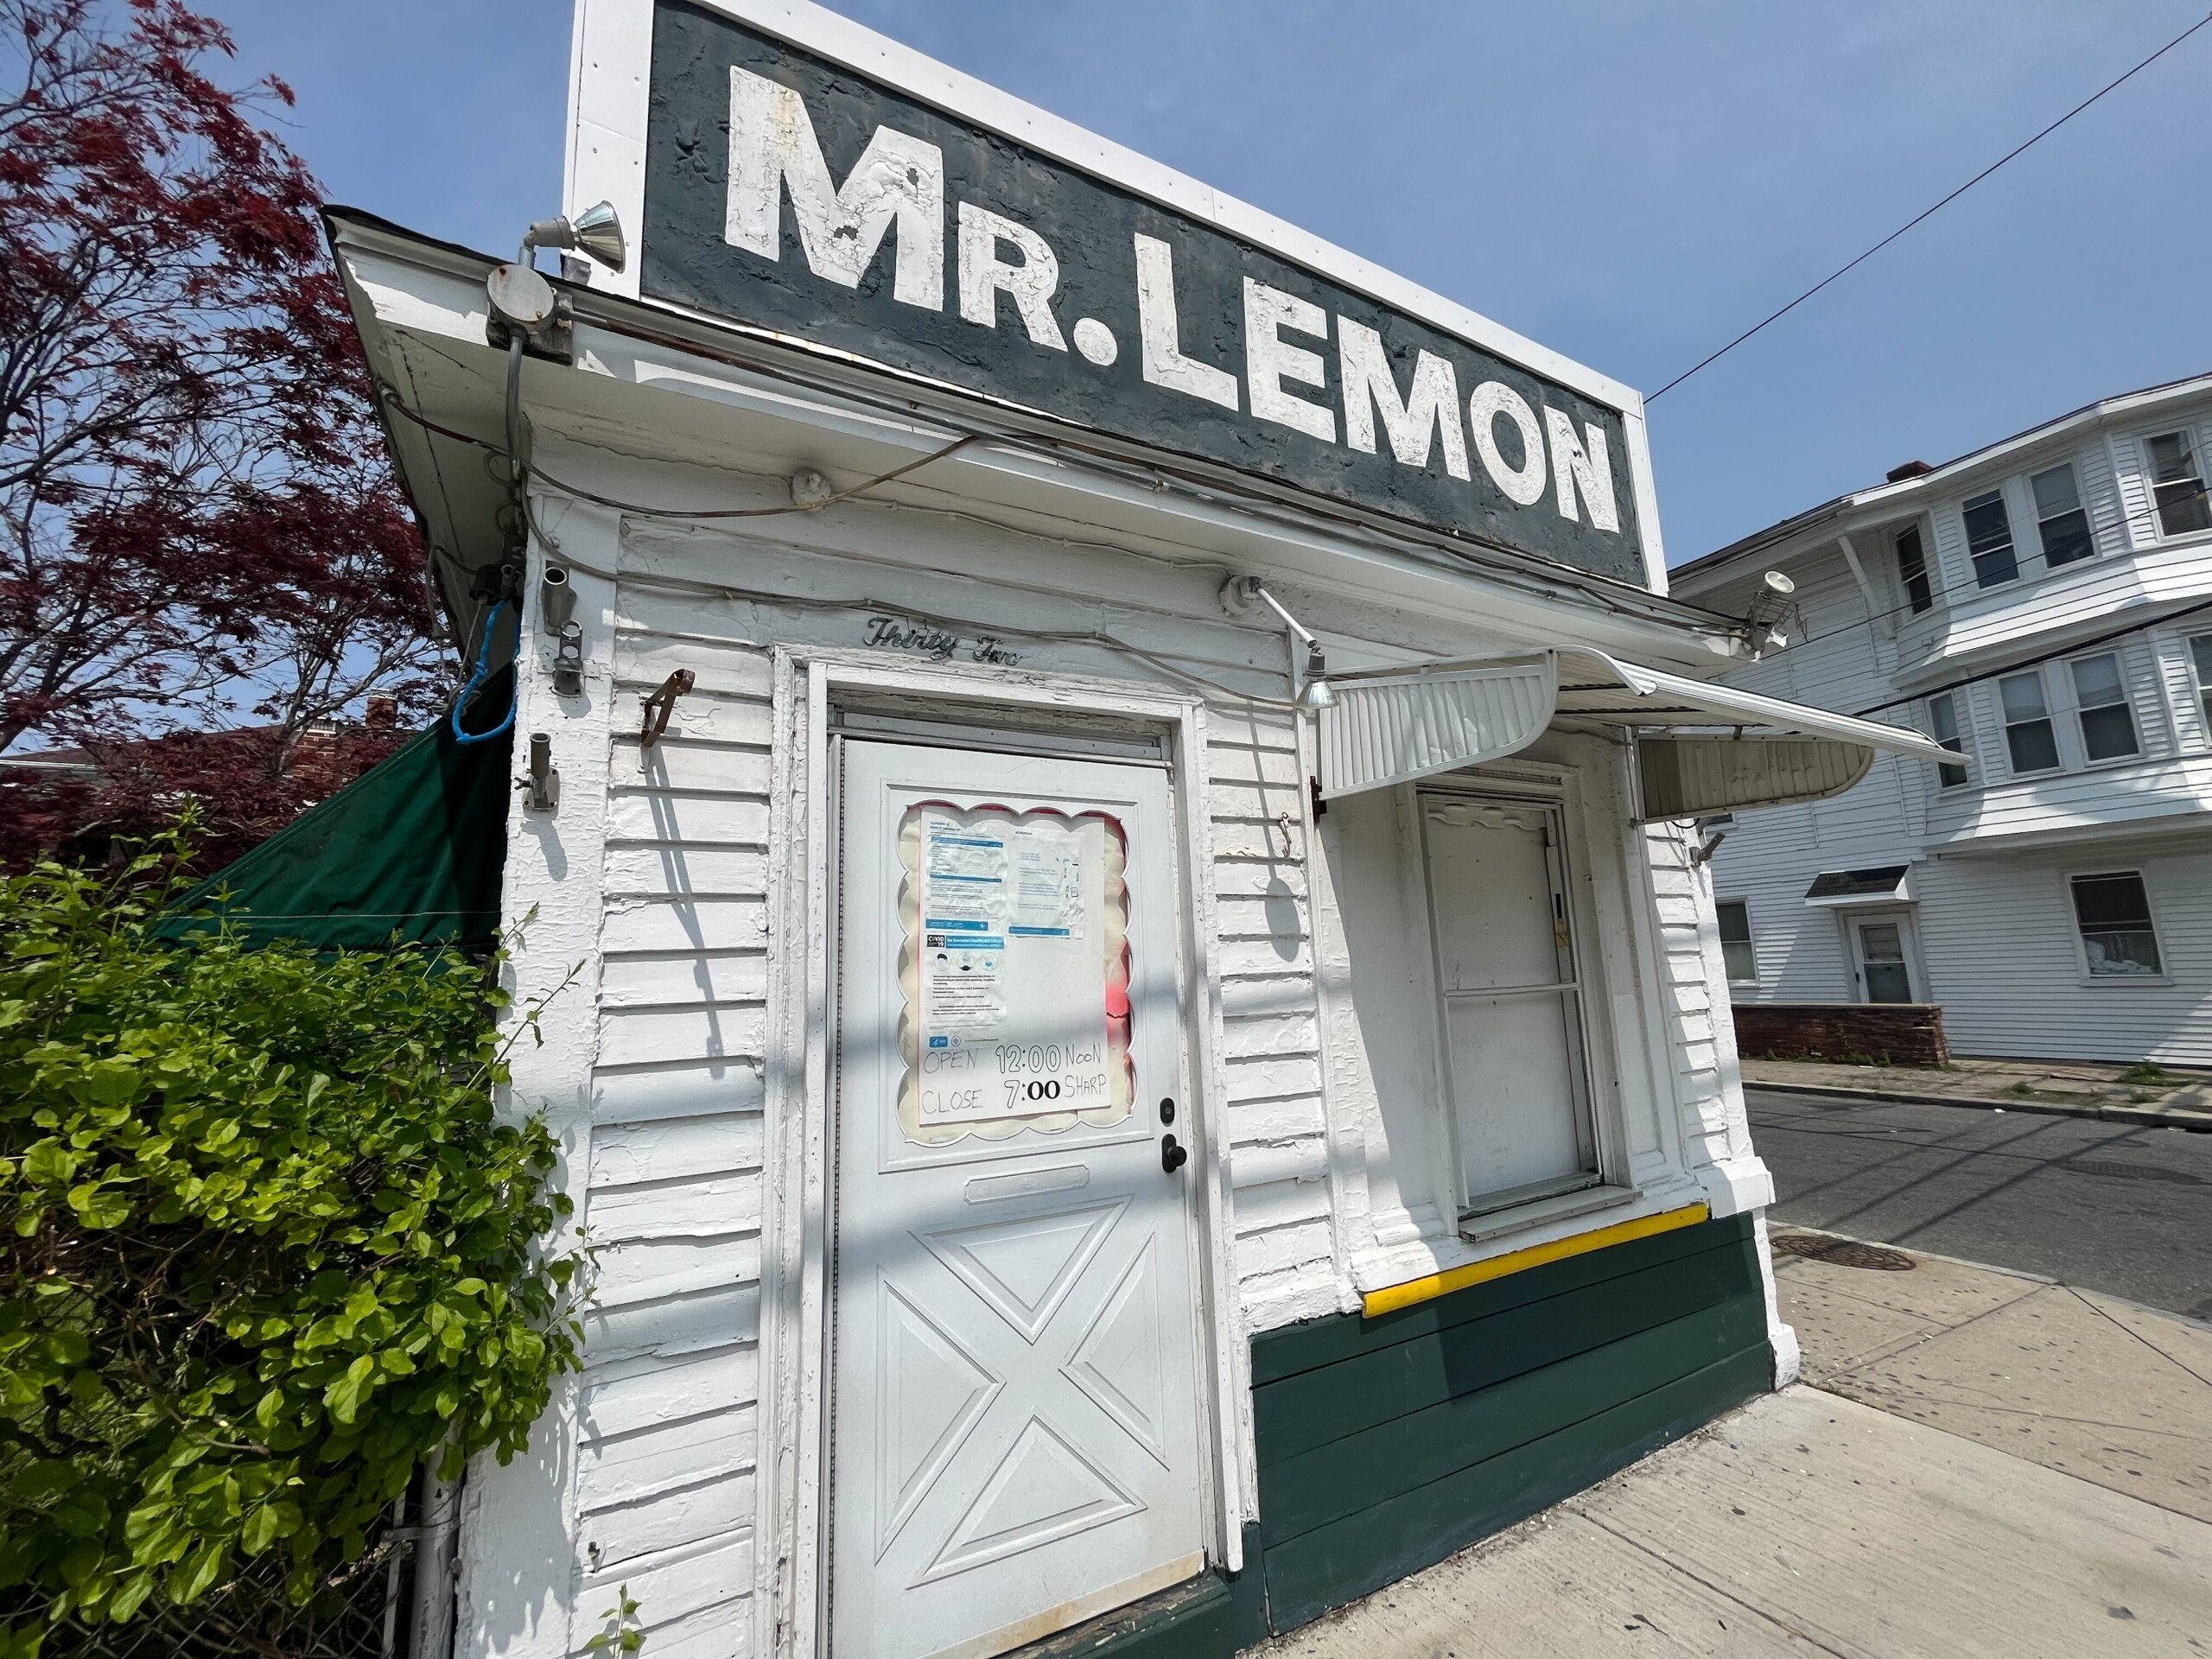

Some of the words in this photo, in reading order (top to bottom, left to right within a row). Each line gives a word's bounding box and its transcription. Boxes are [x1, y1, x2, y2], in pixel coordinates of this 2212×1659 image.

[1134, 232, 1619, 534] LEMON
[864, 616, 958, 661] Thirty
[973, 635, 1026, 666] Two
[924, 1047, 979, 1074] OPEN
[995, 1044, 1061, 1074] 12:00
[922, 1089, 983, 1115] CLOSE
[1004, 1078, 1061, 1109] 7:00
[1064, 1073, 1107, 1098] SHARP
